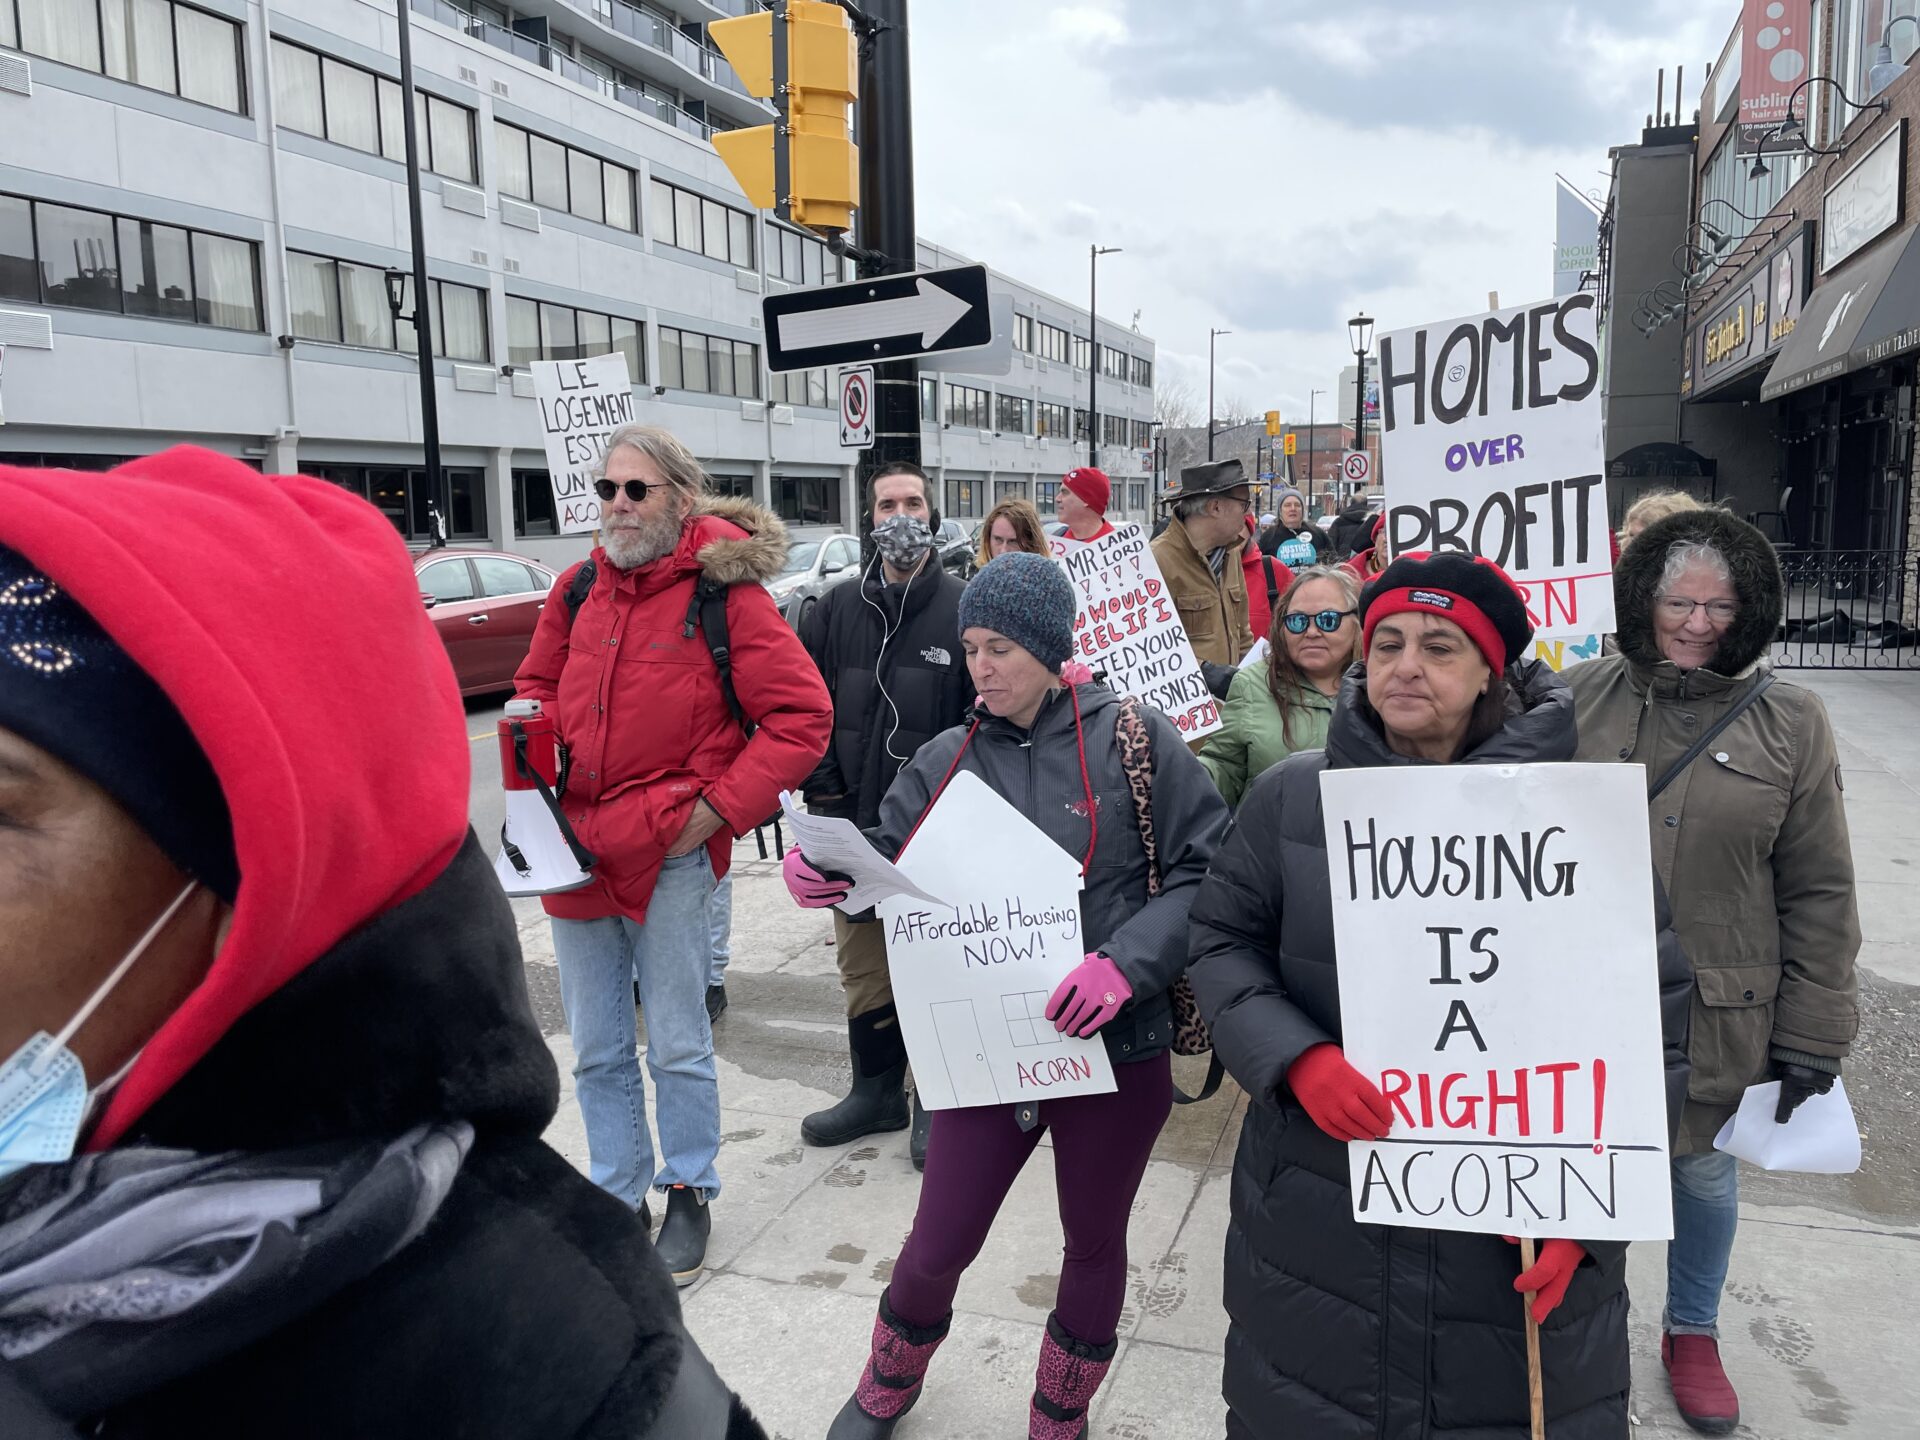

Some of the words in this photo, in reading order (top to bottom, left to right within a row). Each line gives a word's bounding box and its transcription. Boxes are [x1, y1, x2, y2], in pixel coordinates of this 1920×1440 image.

[1742, 93, 1805, 110] sublime
[1752, 110, 1772, 119] hair
[1560, 258, 1594, 270] OPEN
[1561, 245, 1593, 257] NOW
[1893, 328, 1920, 352] TRADE
[556, 362, 599, 391] LE
[1380, 294, 1599, 432] HOMES
[540, 391, 634, 434] LOGEMENT
[1445, 434, 1525, 472] OVER
[554, 471, 586, 496] UN
[563, 502, 600, 526] ACO
[1103, 540, 1144, 567] LORD
[1280, 542, 1312, 554] JUSTICE
[1088, 579, 1162, 624] WOULD
[1122, 607, 1148, 636] IF
[1152, 598, 1173, 623] I
[1135, 625, 1187, 661] YOUR
[1138, 653, 1183, 685] INTO
[1344, 817, 1579, 902] HOUSING
[964, 931, 1047, 968] NOW!
[1425, 926, 1500, 985] IS
[1434, 1000, 1488, 1052] A
[1017, 1055, 1092, 1088] ACORN
[1380, 1058, 1608, 1154] RIGHT!
[1358, 1149, 1619, 1222] ACORN
